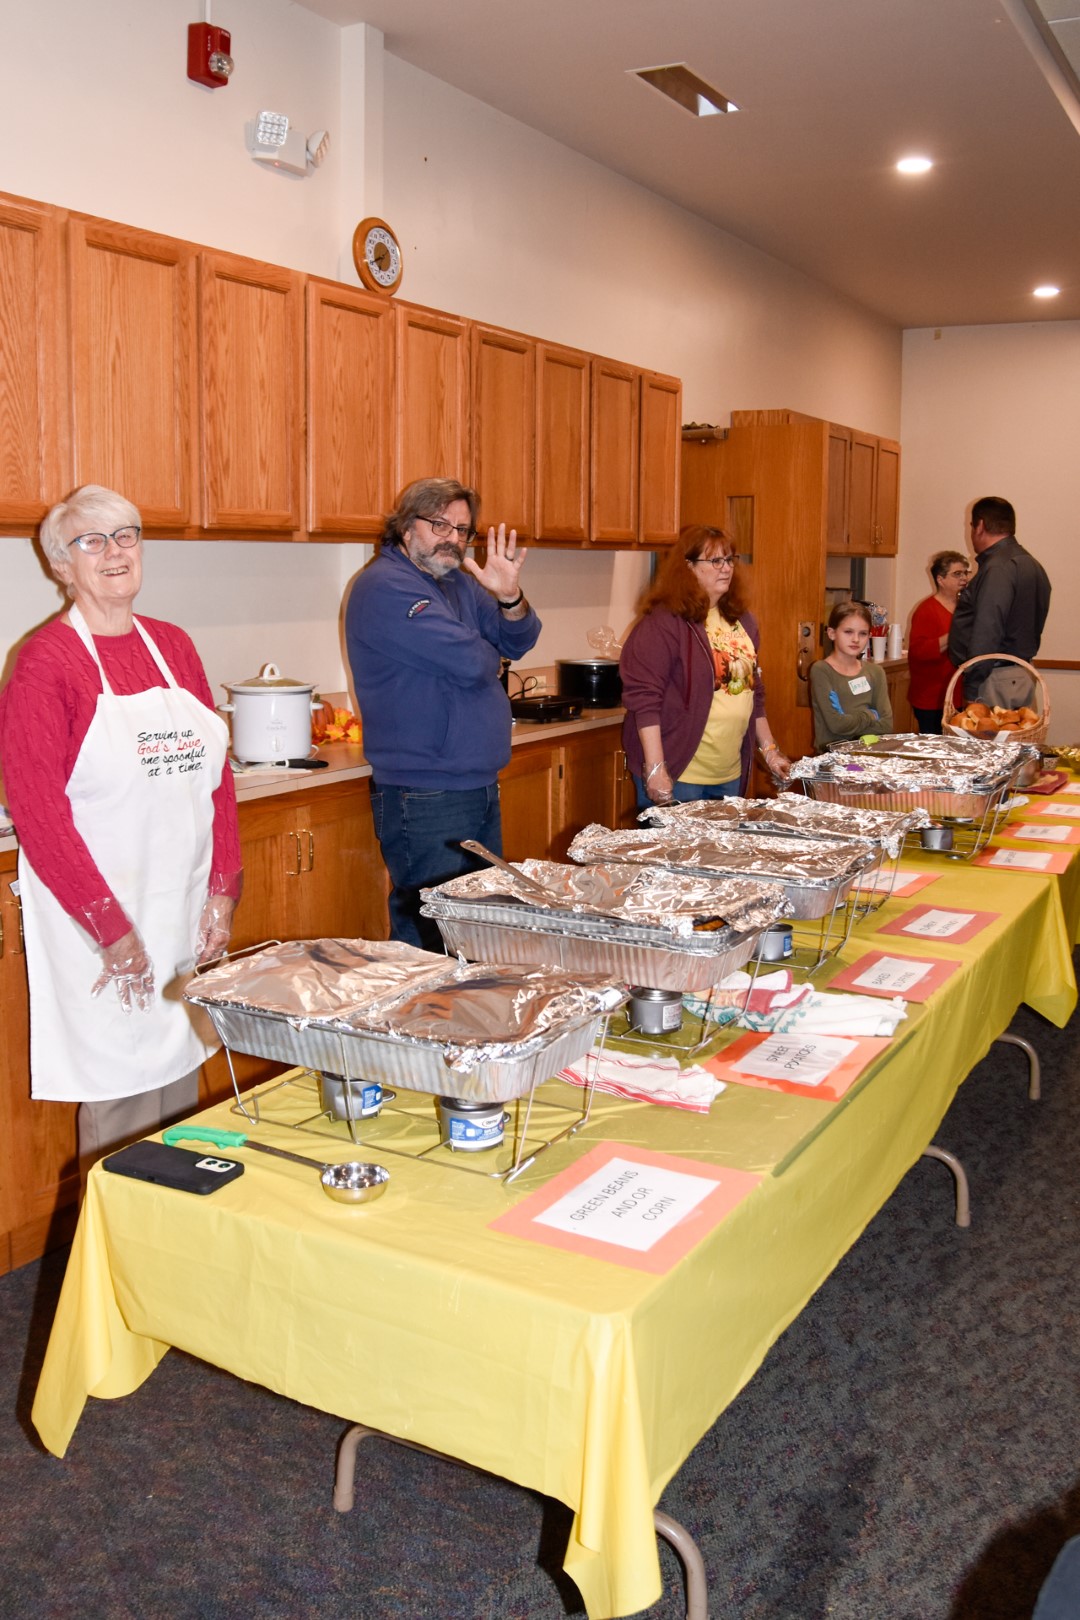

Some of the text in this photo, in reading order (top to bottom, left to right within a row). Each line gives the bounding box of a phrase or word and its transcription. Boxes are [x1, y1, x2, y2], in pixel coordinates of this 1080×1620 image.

[137, 729, 194, 742] Serving up
[137, 738, 203, 755] God's Love
[141, 745, 206, 765] one spoonful
[147, 761, 203, 777] at a time.
[766, 1045, 789, 1062] SWEET
[784, 1044, 817, 1069] POTATOES
[569, 1170, 639, 1221] GREEN BEANS
[611, 1187, 653, 1218] AND OR
[642, 1196, 677, 1221] CORN
